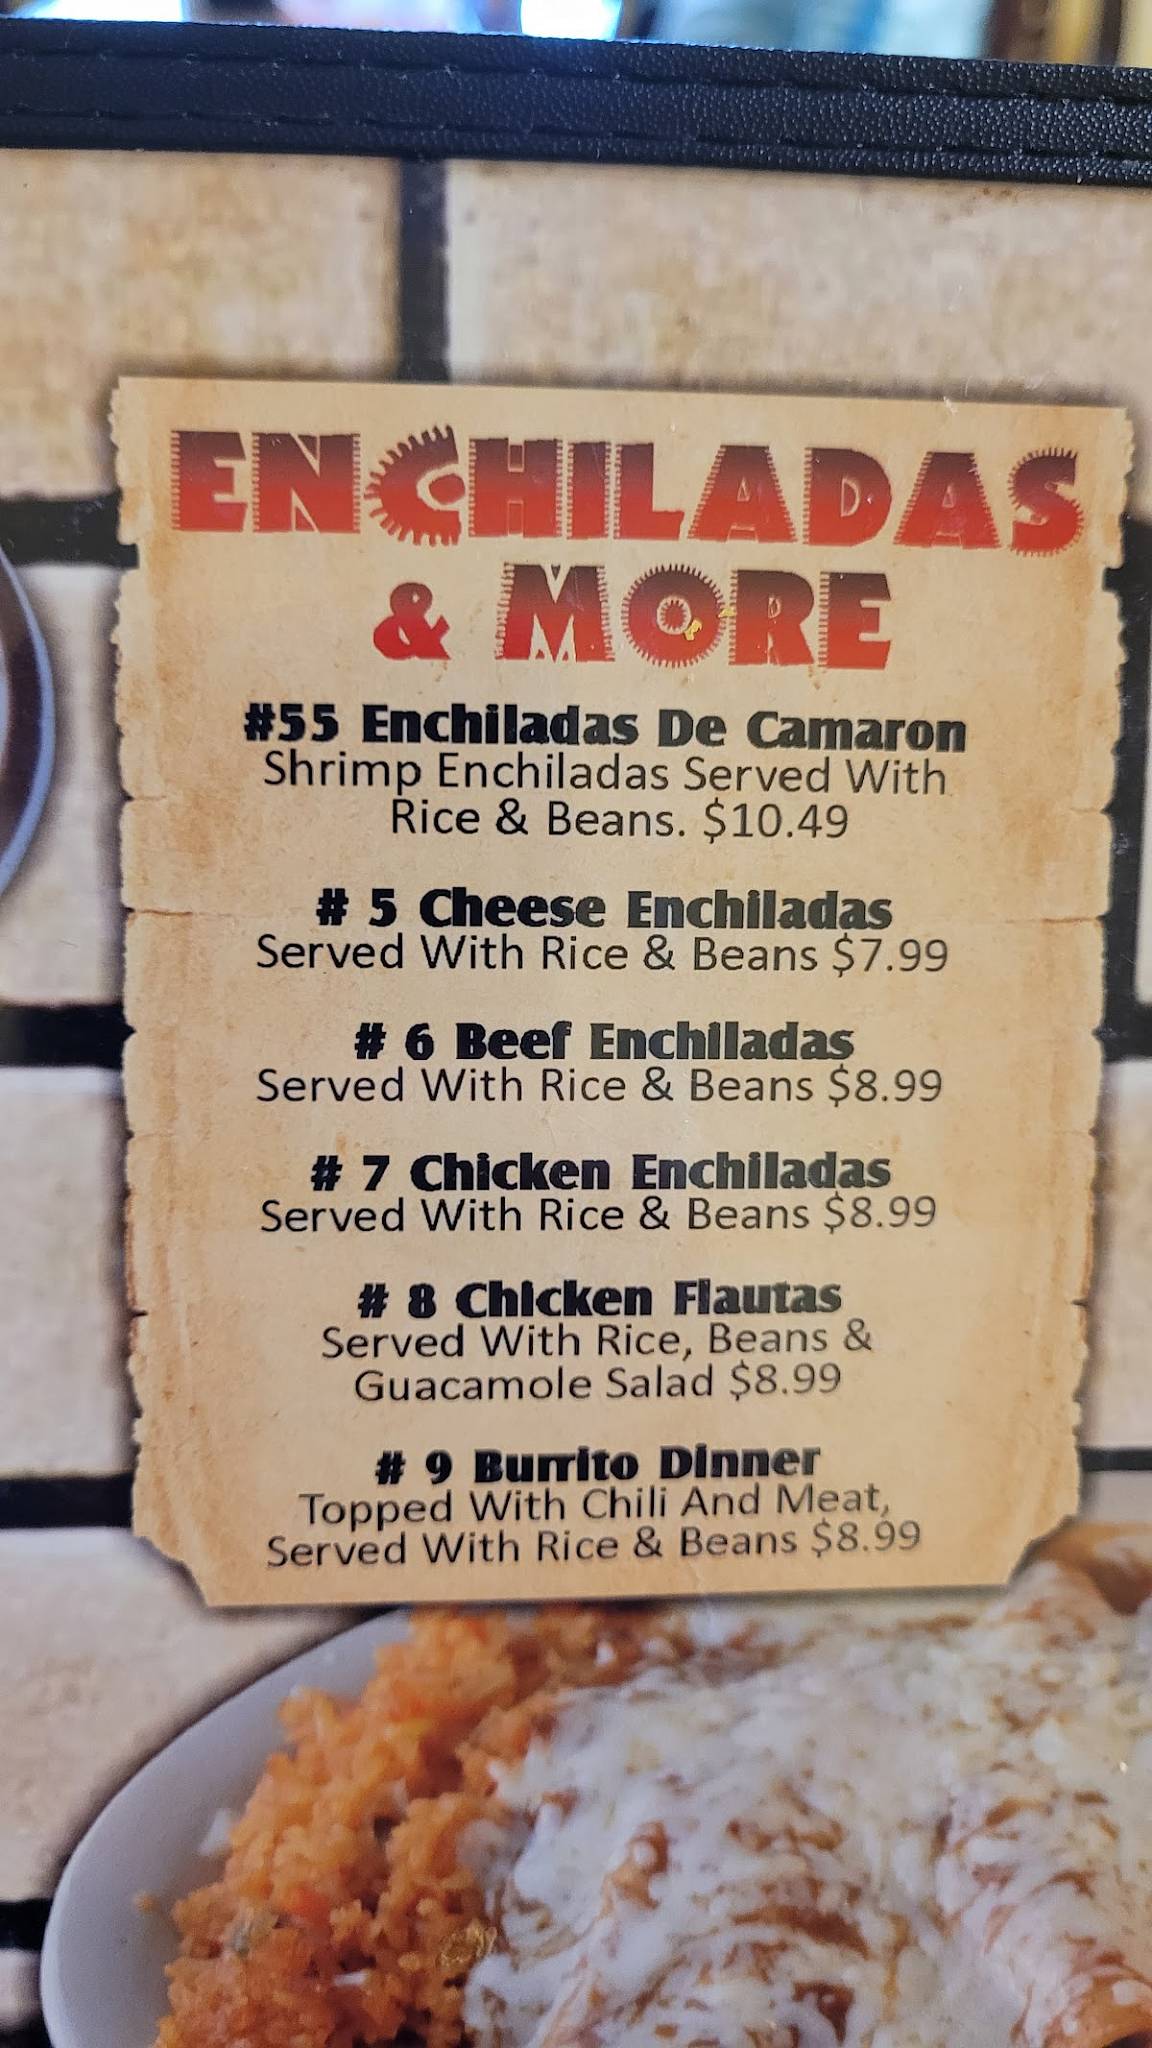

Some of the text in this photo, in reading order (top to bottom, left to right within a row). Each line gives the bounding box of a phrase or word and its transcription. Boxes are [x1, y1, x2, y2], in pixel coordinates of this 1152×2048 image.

[171, 424, 1084, 557] ENCHILADAS
[373, 562, 892, 671] & MORE
[242, 701, 967, 754] #55 Enchiladas De Camaron
[263, 747, 946, 797] Shrimp Enchiladas Served With
[391, 796, 849, 845] Rice & Beans. $10.49
[315, 886, 894, 931] # 5 Cheese Enchiladas
[256, 931, 949, 979] Served With Rice & Beans $7.99
[353, 1019, 855, 1061] # 6 Beef Enchiladas
[255, 1062, 943, 1108] Served With Rice & Beans $8.99
[309, 1150, 892, 1193] # 7 Chicken Enchiladas
[260, 1190, 937, 1235] Served With Rice & Beans $8.99
[356, 1277, 842, 1320] # 8 Chicken Flautas
[321, 1317, 873, 1363] Served With Rice, Beans &
[354, 1359, 842, 1403] Guacamole Salad $8.99
[374, 1442, 822, 1487] # 9 Burrito Dinner
[298, 1481, 889, 1534] Topped With Chili And Meat,
[267, 1517, 921, 1568] Served With Rice & Beans $8.99
